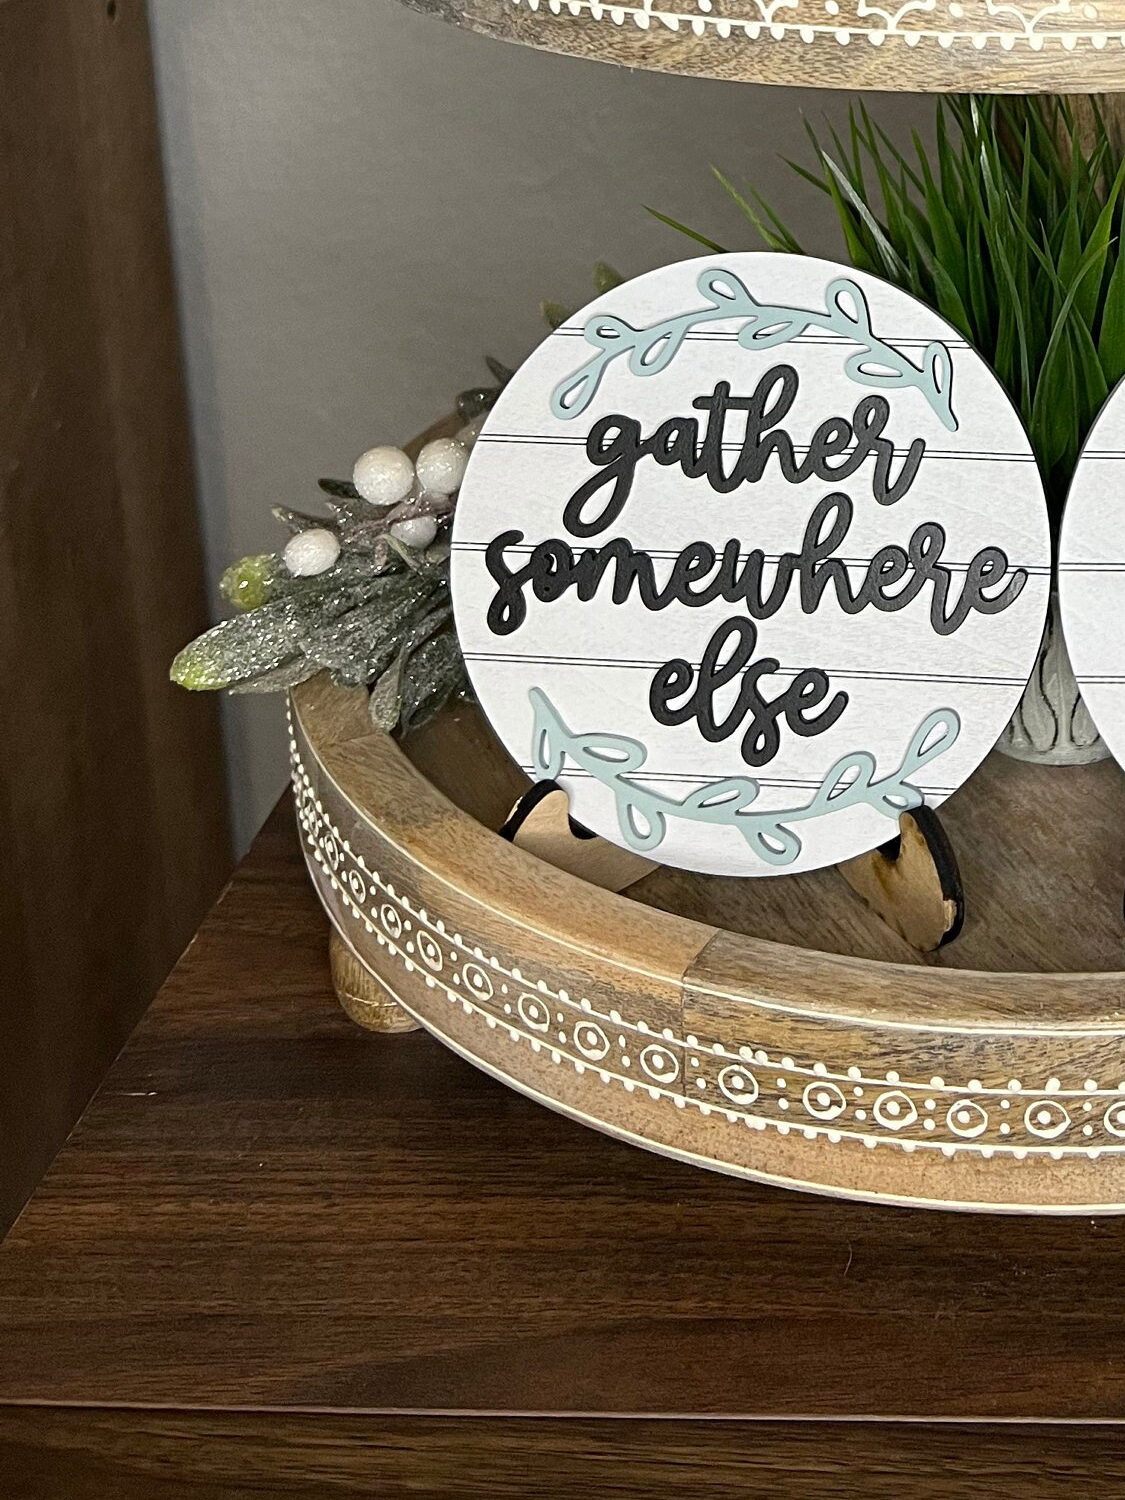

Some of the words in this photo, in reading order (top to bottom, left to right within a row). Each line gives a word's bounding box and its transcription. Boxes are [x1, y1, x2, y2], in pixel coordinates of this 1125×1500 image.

[563, 364, 926, 538] gather
[485, 492, 1029, 636] somewhere
[649, 616, 850, 768] else
